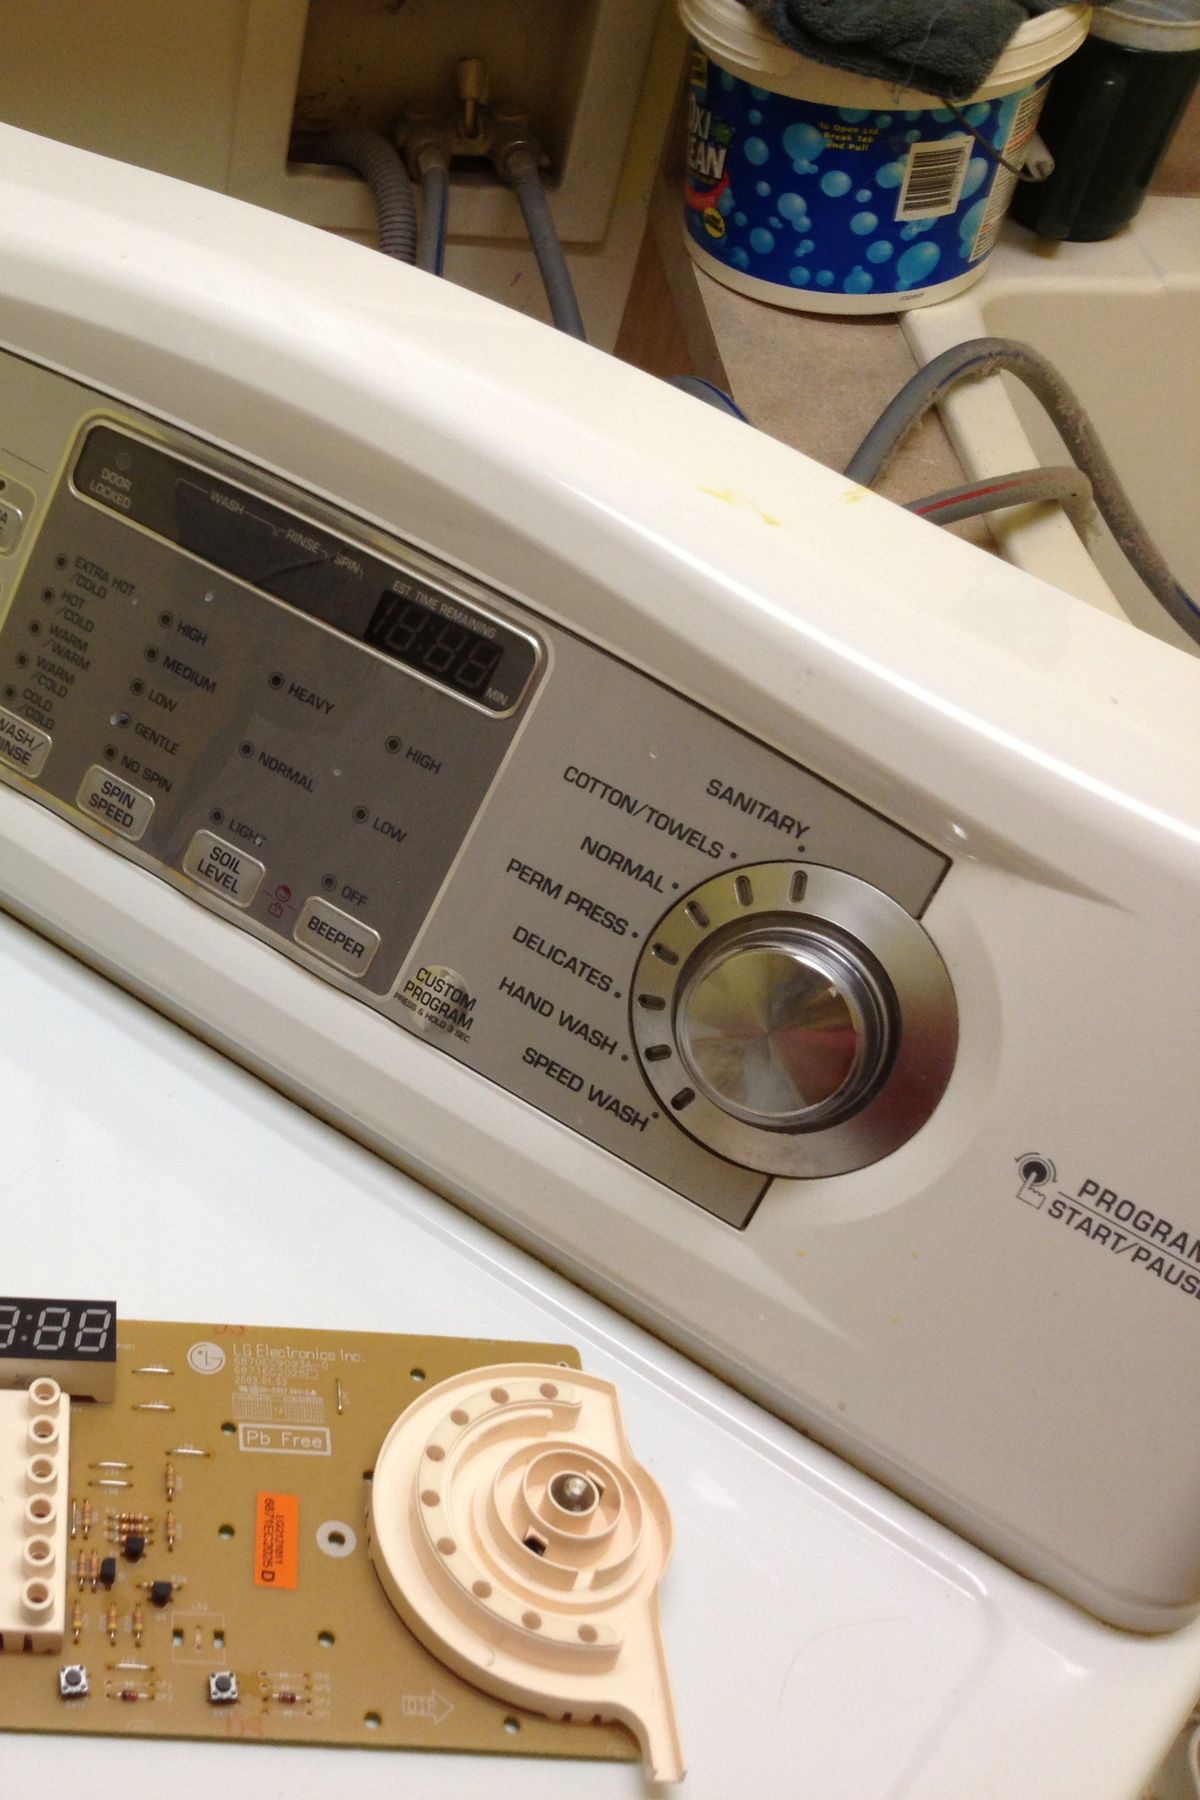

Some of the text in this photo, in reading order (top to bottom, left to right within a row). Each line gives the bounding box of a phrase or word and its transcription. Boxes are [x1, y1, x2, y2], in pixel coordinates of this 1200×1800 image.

[90, 479, 132, 510] LOCKED
[100, 467, 132, 492] DOOR
[210, 489, 246, 516] WASH
[286, 529, 322, 554] RINSE
[74, 555, 137, 598] EXTRA HOT
[333, 554, 362, 575] SPIN
[61, 590, 87, 611] HOT
[415, 591, 440, 611] TIME
[439, 604, 498, 640] REMAINING
[56, 605, 96, 634] /COLD
[176, 621, 209, 647] HIGH
[49, 623, 89, 652] WARM
[35, 655, 76, 686] WARM
[161, 655, 218, 695] MEDIUM
[22, 688, 54, 713] COLD
[147, 689, 178, 714] LOW
[287, 682, 336, 717] HEAVY
[134, 722, 180, 757] GENTLE
[120, 754, 174, 794] NO SPIN
[257, 750, 315, 794] NORMAL
[404, 746, 443, 776] HIGH
[88, 793, 135, 829] SPEED
[100, 780, 137, 810] SPIN
[705, 778, 811, 840] SANITARY
[562, 765, 726, 860] COTTON/TOWELS
[227, 817, 268, 850] LIGHT
[371, 816, 408, 844] LOW
[196, 858, 240, 895] LEVEL
[208, 845, 242, 876] SOIL
[579, 835, 666, 894] NORMAL
[339, 885, 369, 908] OFF
[505, 857, 631, 938] PERM PRESS
[306, 915, 367, 960] BEEPER
[511, 925, 615, 994] DELICATES
[415, 966, 478, 1012] CUSTOM
[402, 980, 475, 1031] PROGRAM
[424, 1012, 447, 1030] HOLD
[497, 976, 619, 1056] HAND WASH
[521, 1046, 651, 1133] SPEED WASH
[1046, 1199, 1200, 1301] START/PAUS
[232, 1343, 252, 1358] LG
[256, 1343, 337, 1362] Electronics
[246, 1430, 323, 1449] Pb Free
[259, 1569, 276, 1583] D
